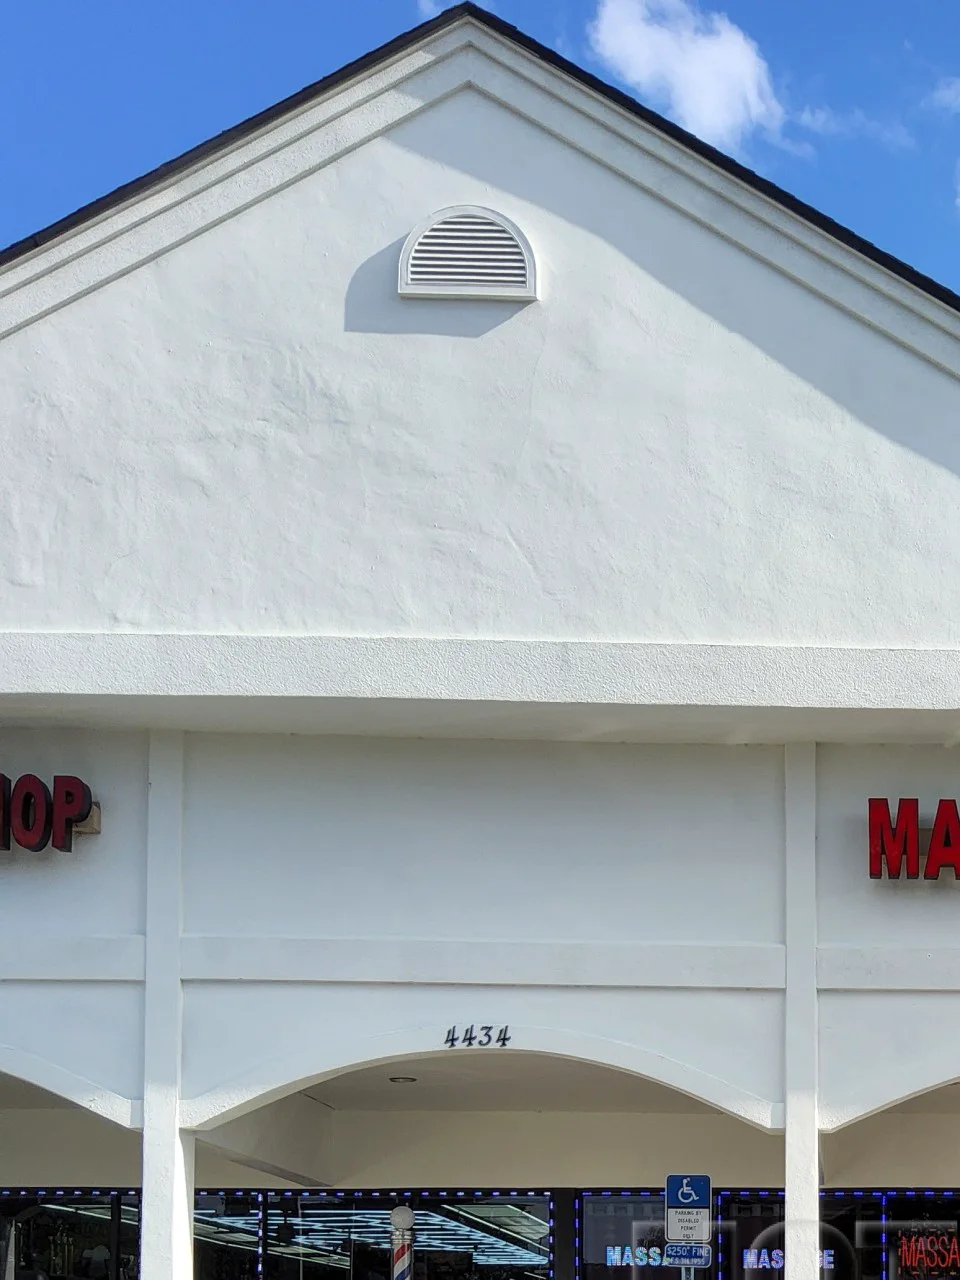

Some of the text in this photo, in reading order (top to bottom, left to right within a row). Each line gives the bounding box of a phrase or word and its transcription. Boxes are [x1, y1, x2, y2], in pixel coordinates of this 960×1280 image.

[444, 1024, 511, 1048] 4434
[606, 1246, 667, 1266] MASS
[692, 1247, 709, 1257] FINE
